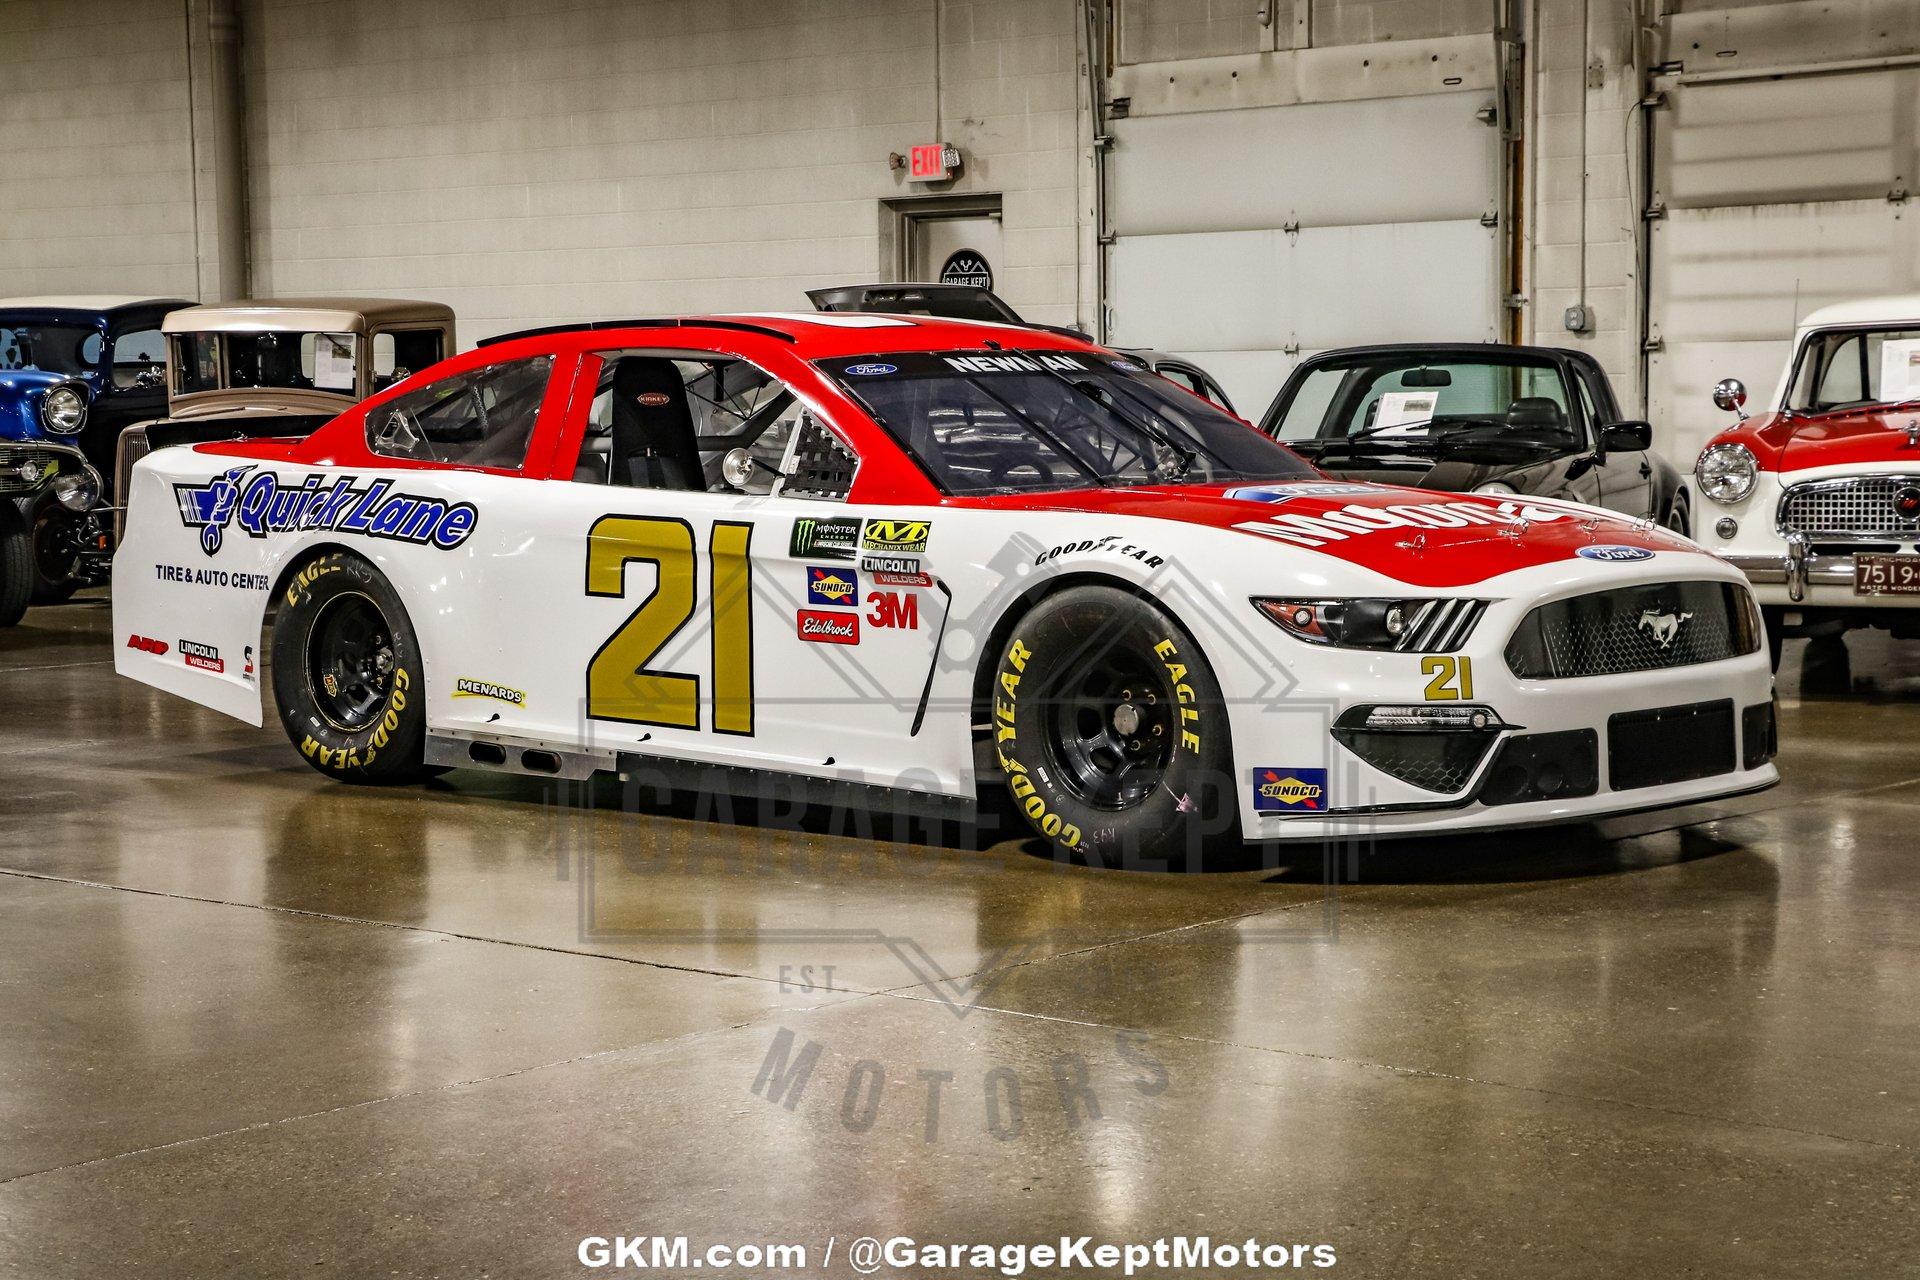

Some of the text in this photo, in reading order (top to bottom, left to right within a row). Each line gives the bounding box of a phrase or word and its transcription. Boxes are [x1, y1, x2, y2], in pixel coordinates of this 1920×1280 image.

[912, 144, 942, 177] EXIT
[970, 276, 986, 287] KEPT
[238, 474, 478, 547] Quick Lane
[816, 524, 856, 534] MONSTER
[863, 541, 901, 551] MECHANIX
[902, 543, 926, 552] WEAR
[1035, 536, 1164, 569] GOODYEAR
[1590, 547, 1645, 560] Ford
[864, 558, 917, 574] LINCOLN
[156, 565, 269, 591] TIRE & AUTO CENTER
[881, 574, 927, 585] WELDERS
[814, 582, 853, 594] SUNOCO
[866, 592, 918, 630] 3M
[585, 513, 755, 737] 21
[803, 618, 854, 637] Edelbrock
[180, 641, 217, 659] LINCOLN
[189, 656, 221, 671] WELDERS
[1421, 656, 1473, 701] 21
[458, 680, 522, 703] MENARDS
[1153, 638, 1200, 754] EAGLE
[996, 639, 1082, 848] GOODYEAR
[1263, 785, 1319, 797] SUNOCO
